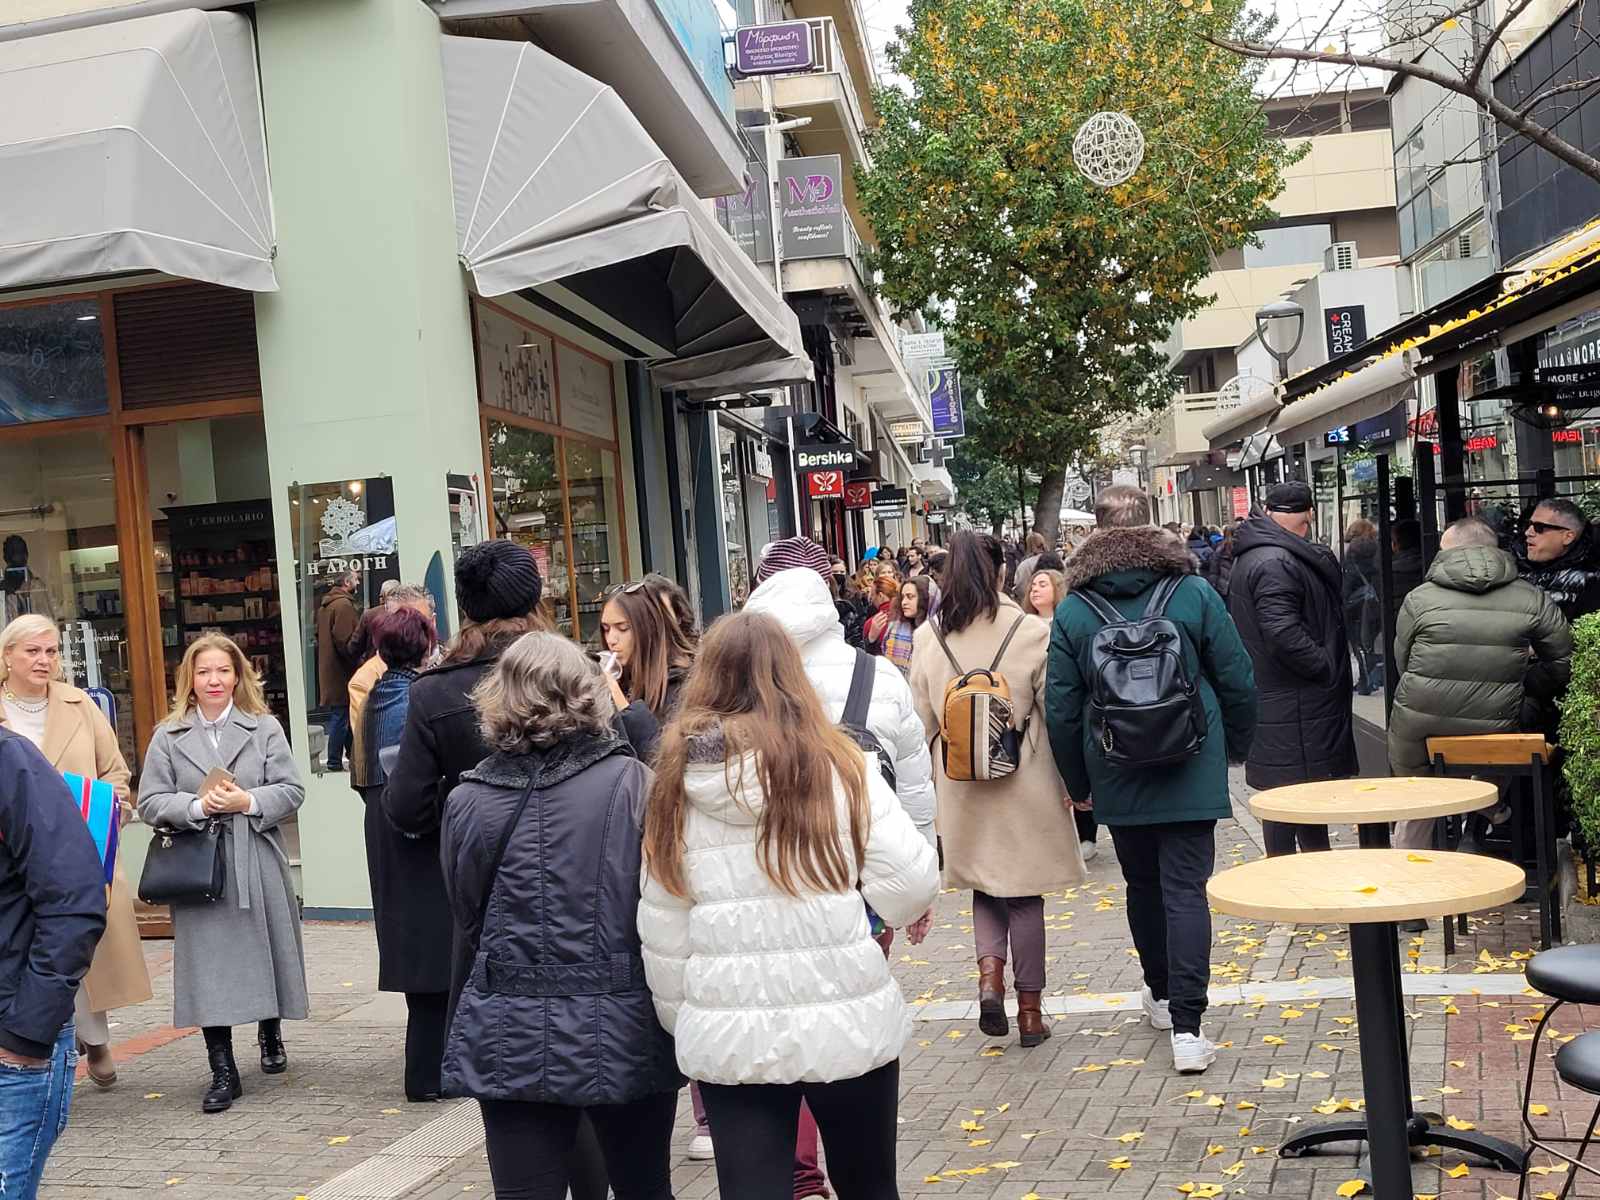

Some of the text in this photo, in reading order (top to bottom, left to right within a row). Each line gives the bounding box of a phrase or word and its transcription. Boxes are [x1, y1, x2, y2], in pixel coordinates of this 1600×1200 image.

[1341, 312, 1352, 352] CREAM
[1547, 373, 1579, 383] MORE
[1466, 436, 1497, 450] JEAN
[798, 450, 853, 467] Bershka
[326, 556, 387, 574] ΔΡΟΓΗ
